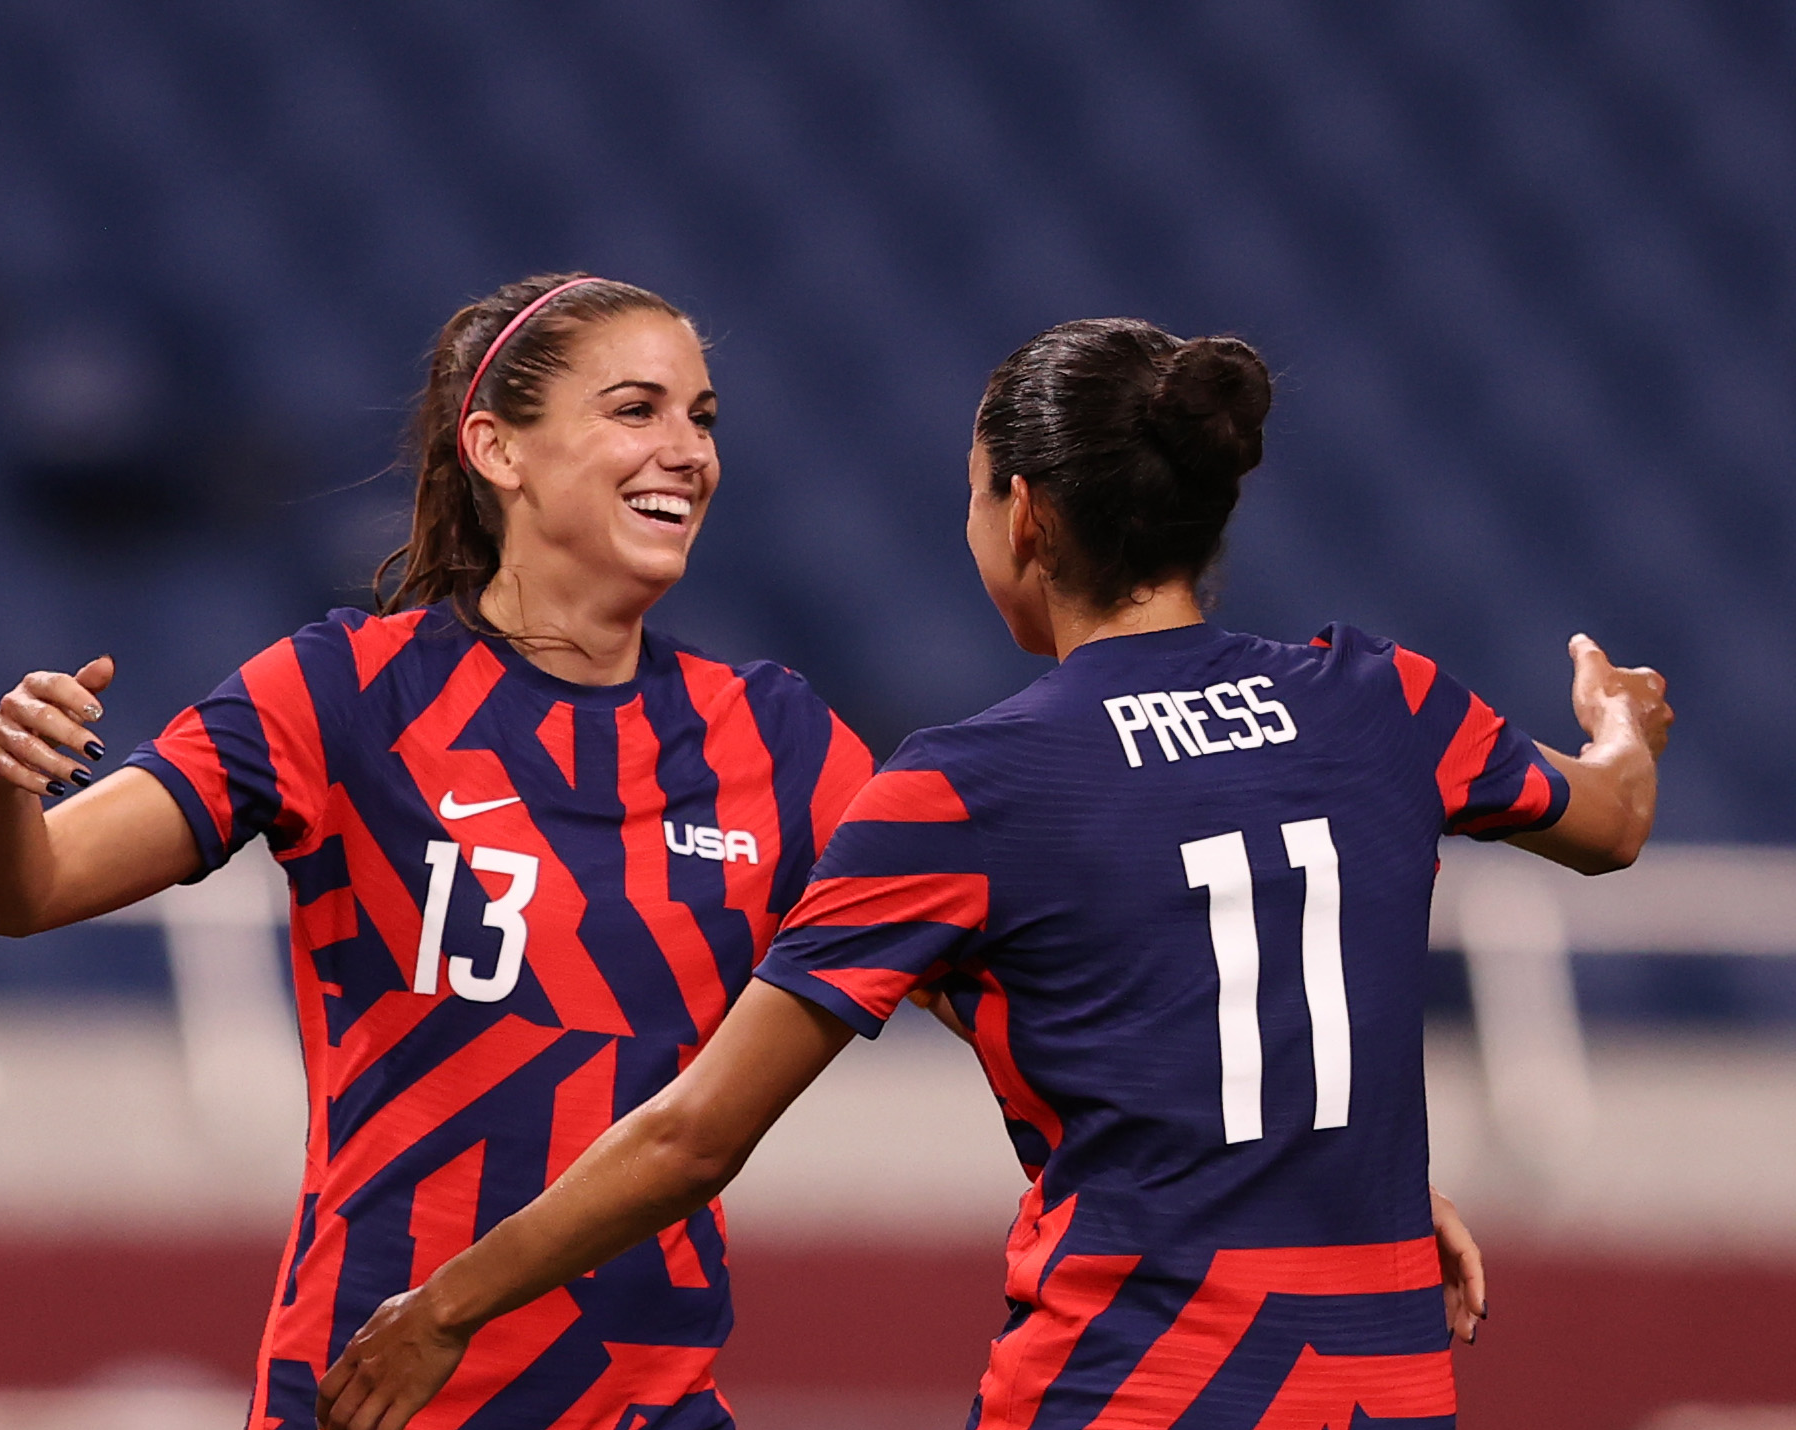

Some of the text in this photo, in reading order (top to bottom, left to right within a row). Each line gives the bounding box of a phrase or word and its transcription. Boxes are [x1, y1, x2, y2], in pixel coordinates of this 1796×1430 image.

[1103, 676, 1298, 768] PRESS
[663, 820, 758, 864] USA
[413, 840, 539, 1003] 13
[1180, 817, 1352, 1145] 11
